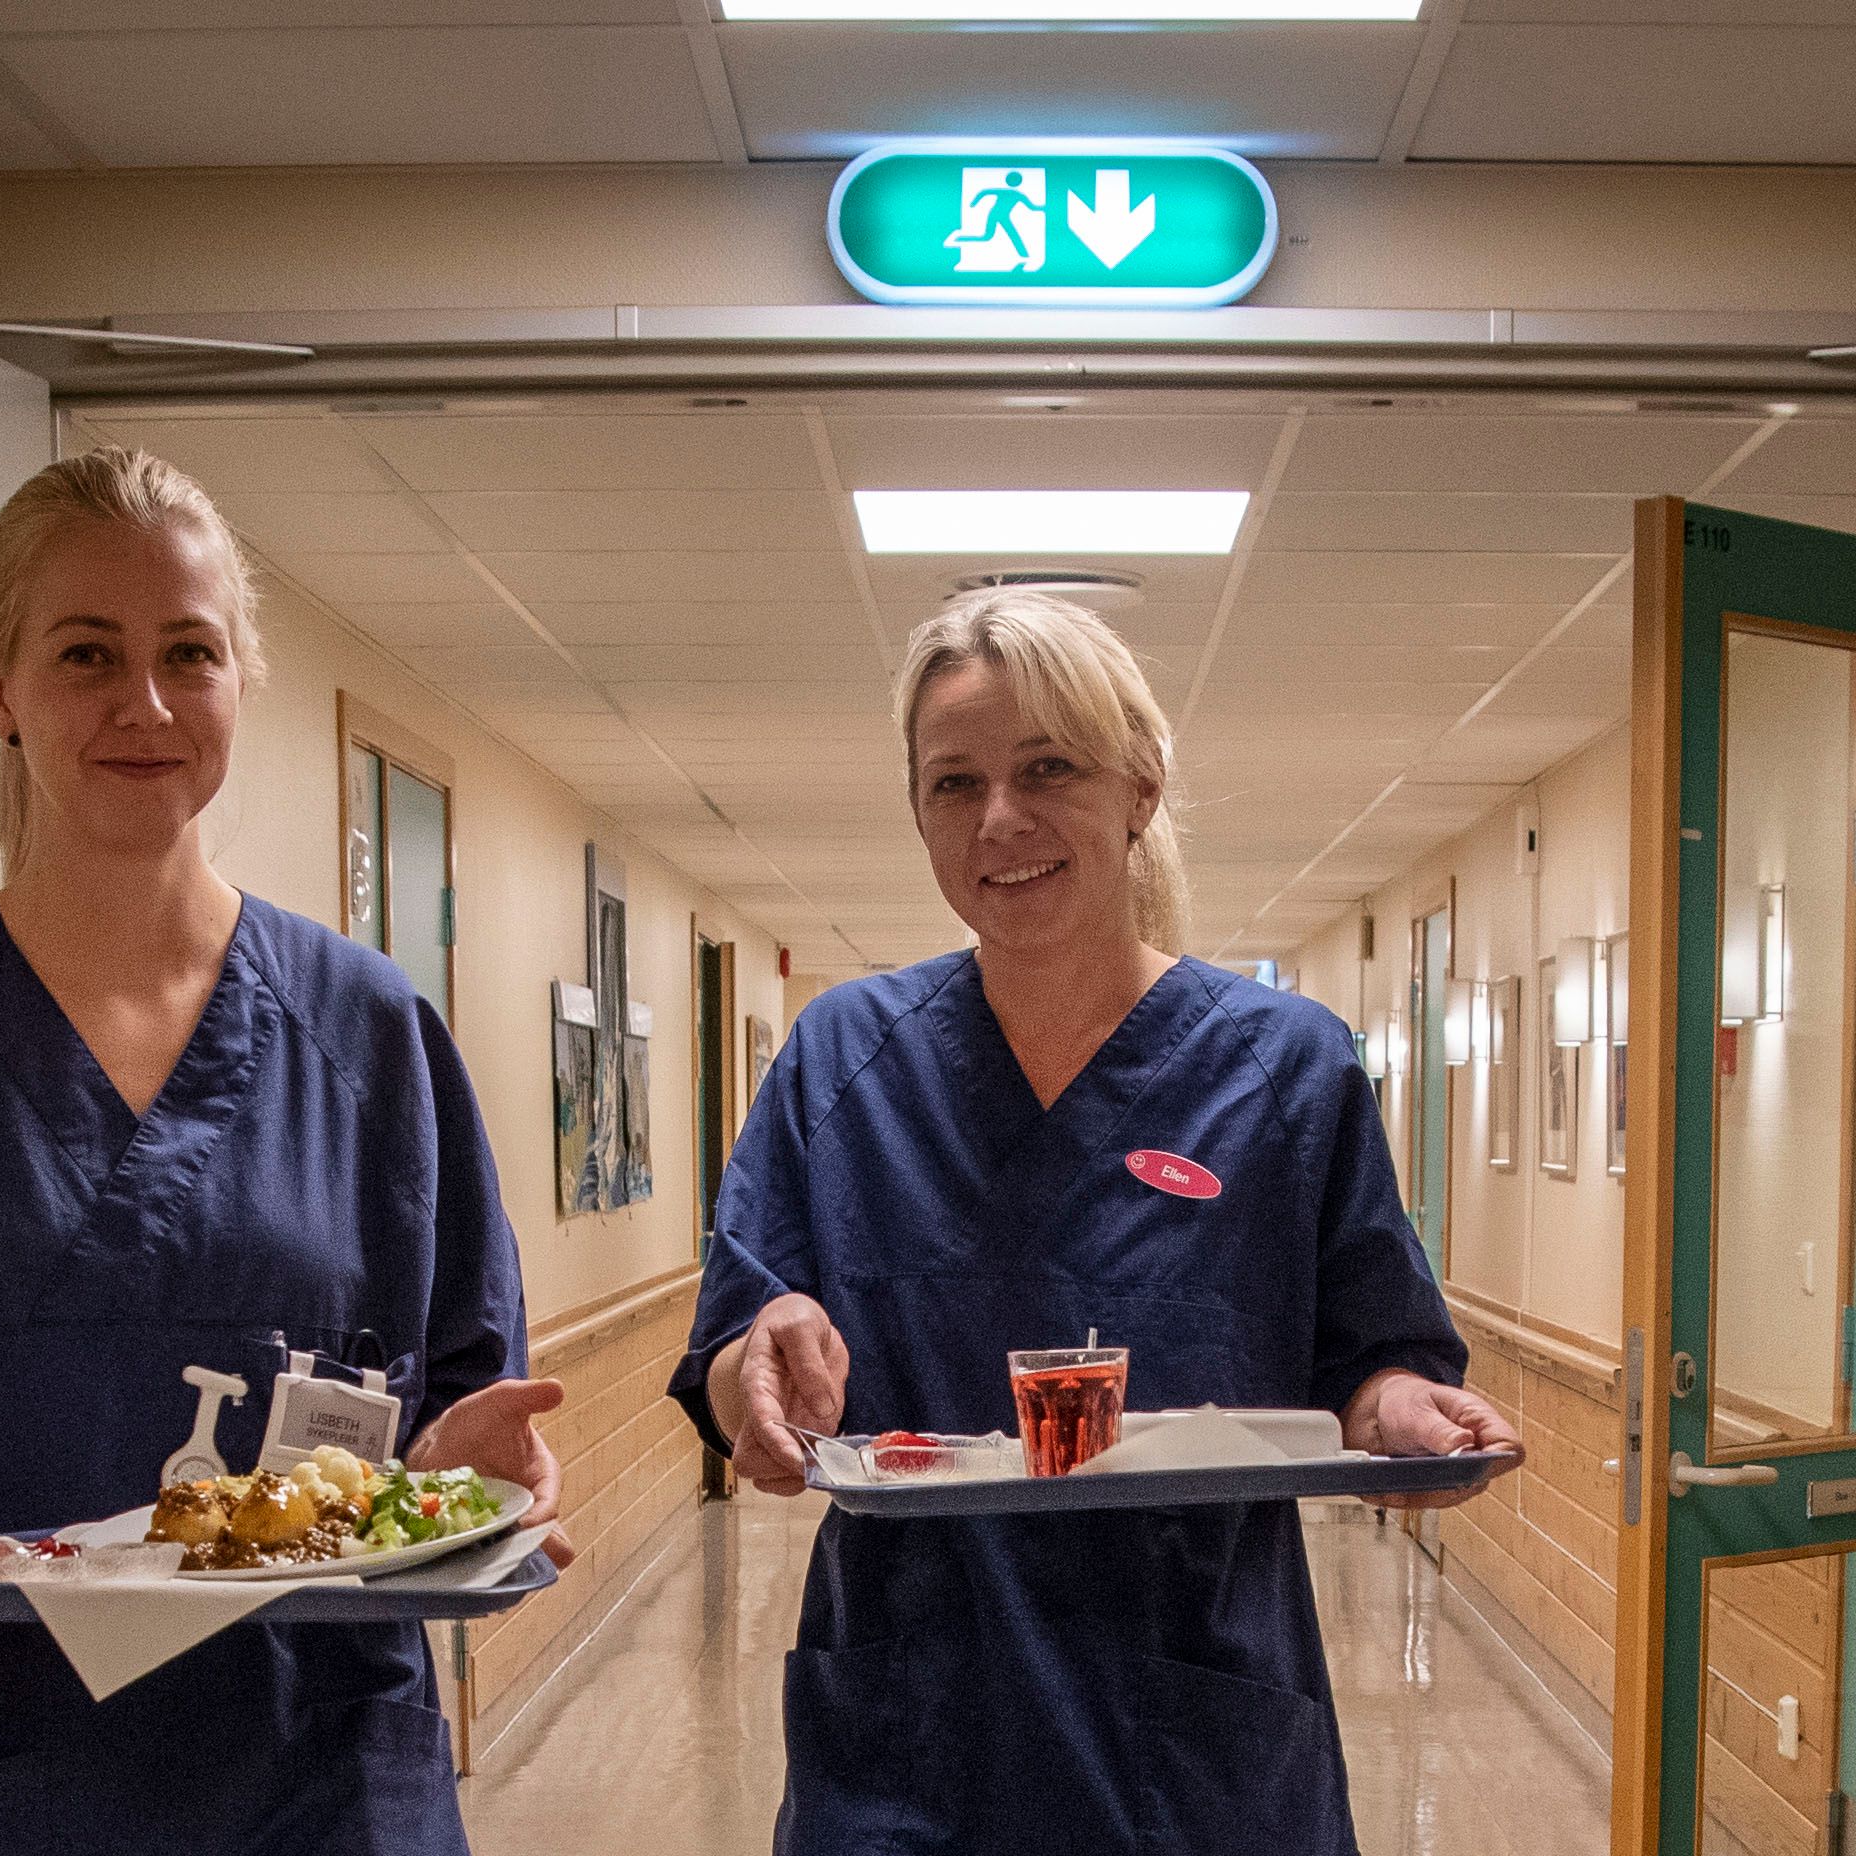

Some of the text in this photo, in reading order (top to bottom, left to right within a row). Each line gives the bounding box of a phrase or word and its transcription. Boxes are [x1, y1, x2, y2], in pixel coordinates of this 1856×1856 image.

[1701, 524, 1730, 552] 110
[1161, 1164, 1190, 1184] Ellen
[310, 1410, 360, 1432] LISBETH
